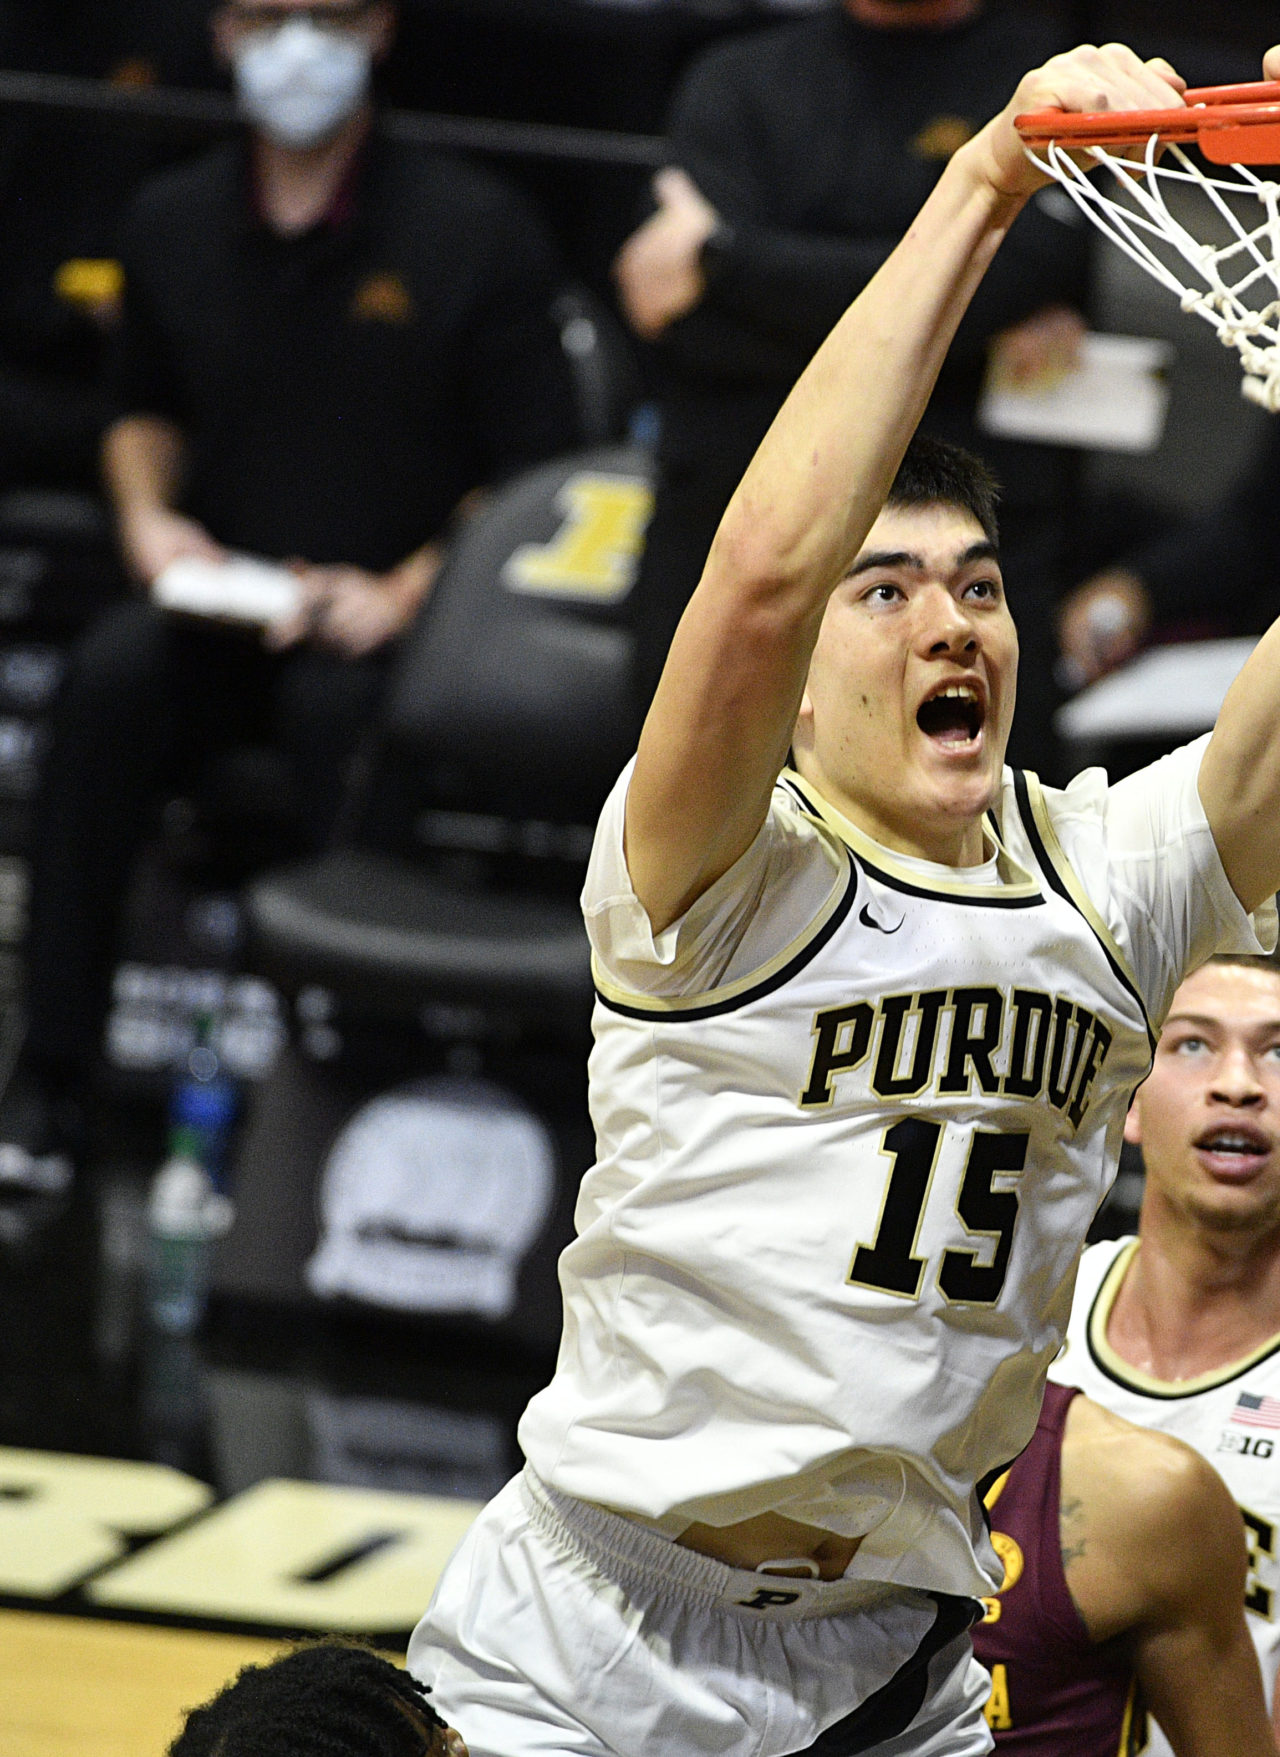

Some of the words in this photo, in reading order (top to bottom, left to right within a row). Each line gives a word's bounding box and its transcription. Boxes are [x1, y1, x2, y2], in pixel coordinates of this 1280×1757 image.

[800, 984, 1113, 1138] PURDUE
[846, 1116, 1031, 1306] 15
[733, 1586, 802, 1611] P
